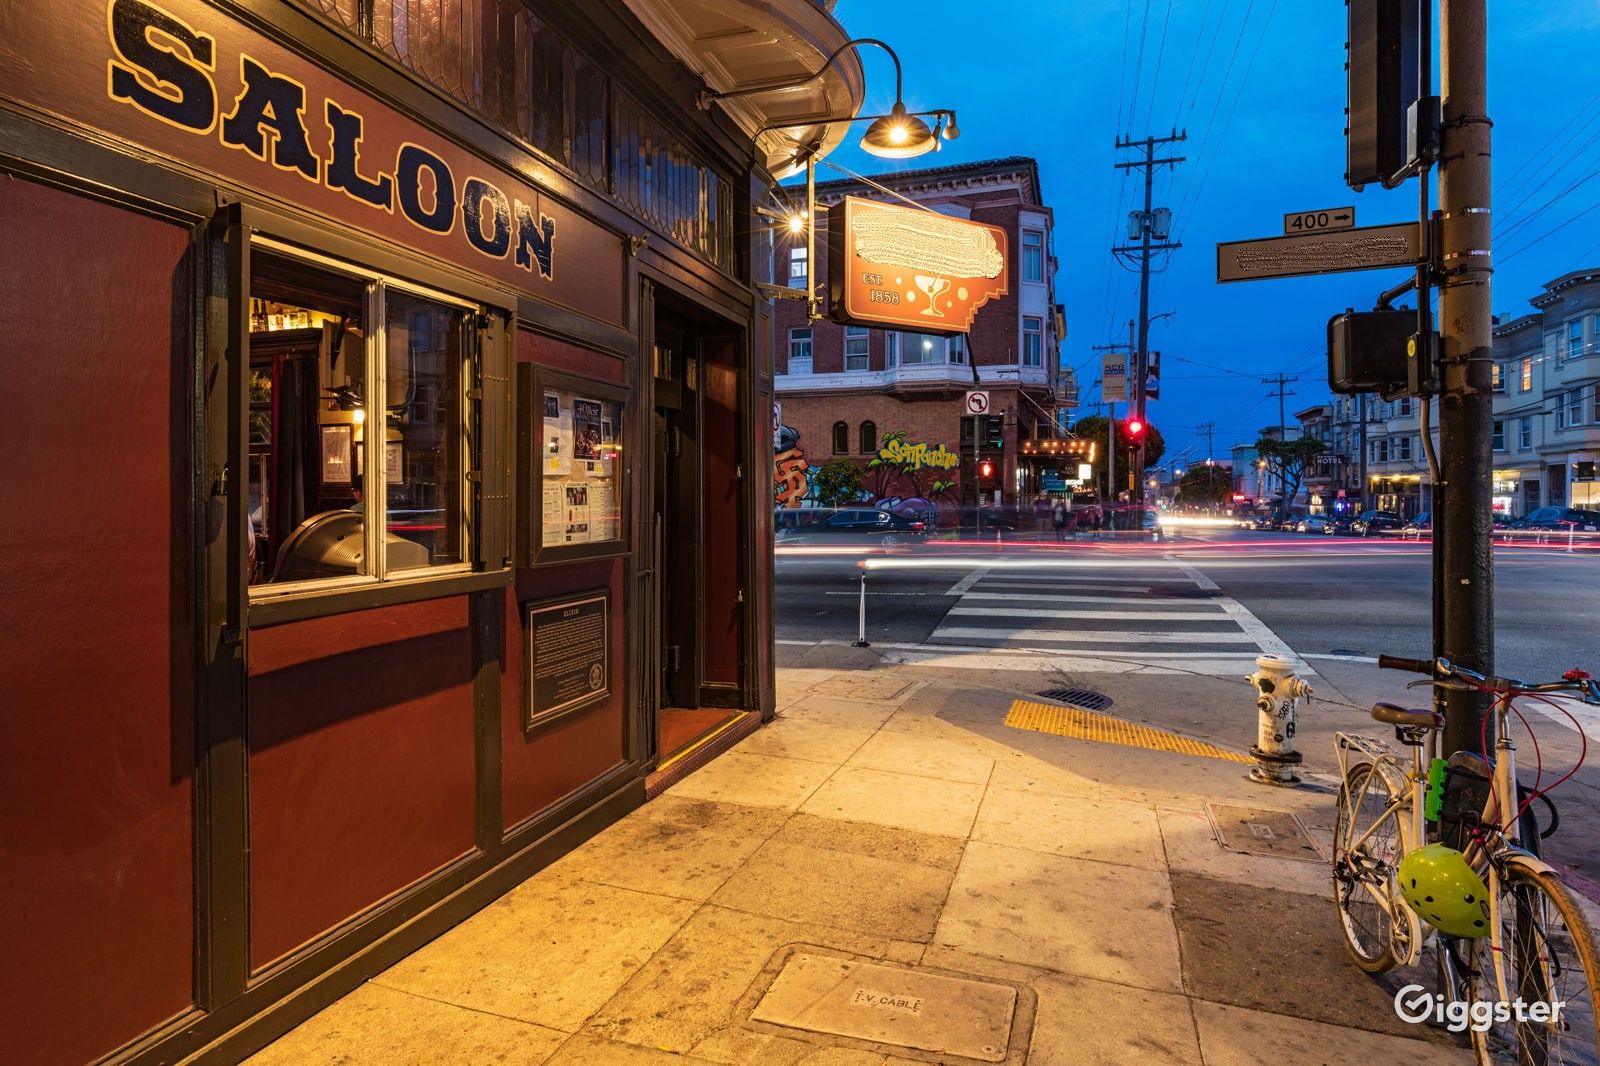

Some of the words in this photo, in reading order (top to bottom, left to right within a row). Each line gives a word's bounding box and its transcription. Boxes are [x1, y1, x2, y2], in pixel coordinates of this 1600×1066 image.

[107, 0, 556, 281] SALOON
[1290, 212, 1329, 230] 400
[862, 273, 883, 286] EST.
[871, 289, 900, 305] 1858
[879, 996, 923, 1011] CABLE
